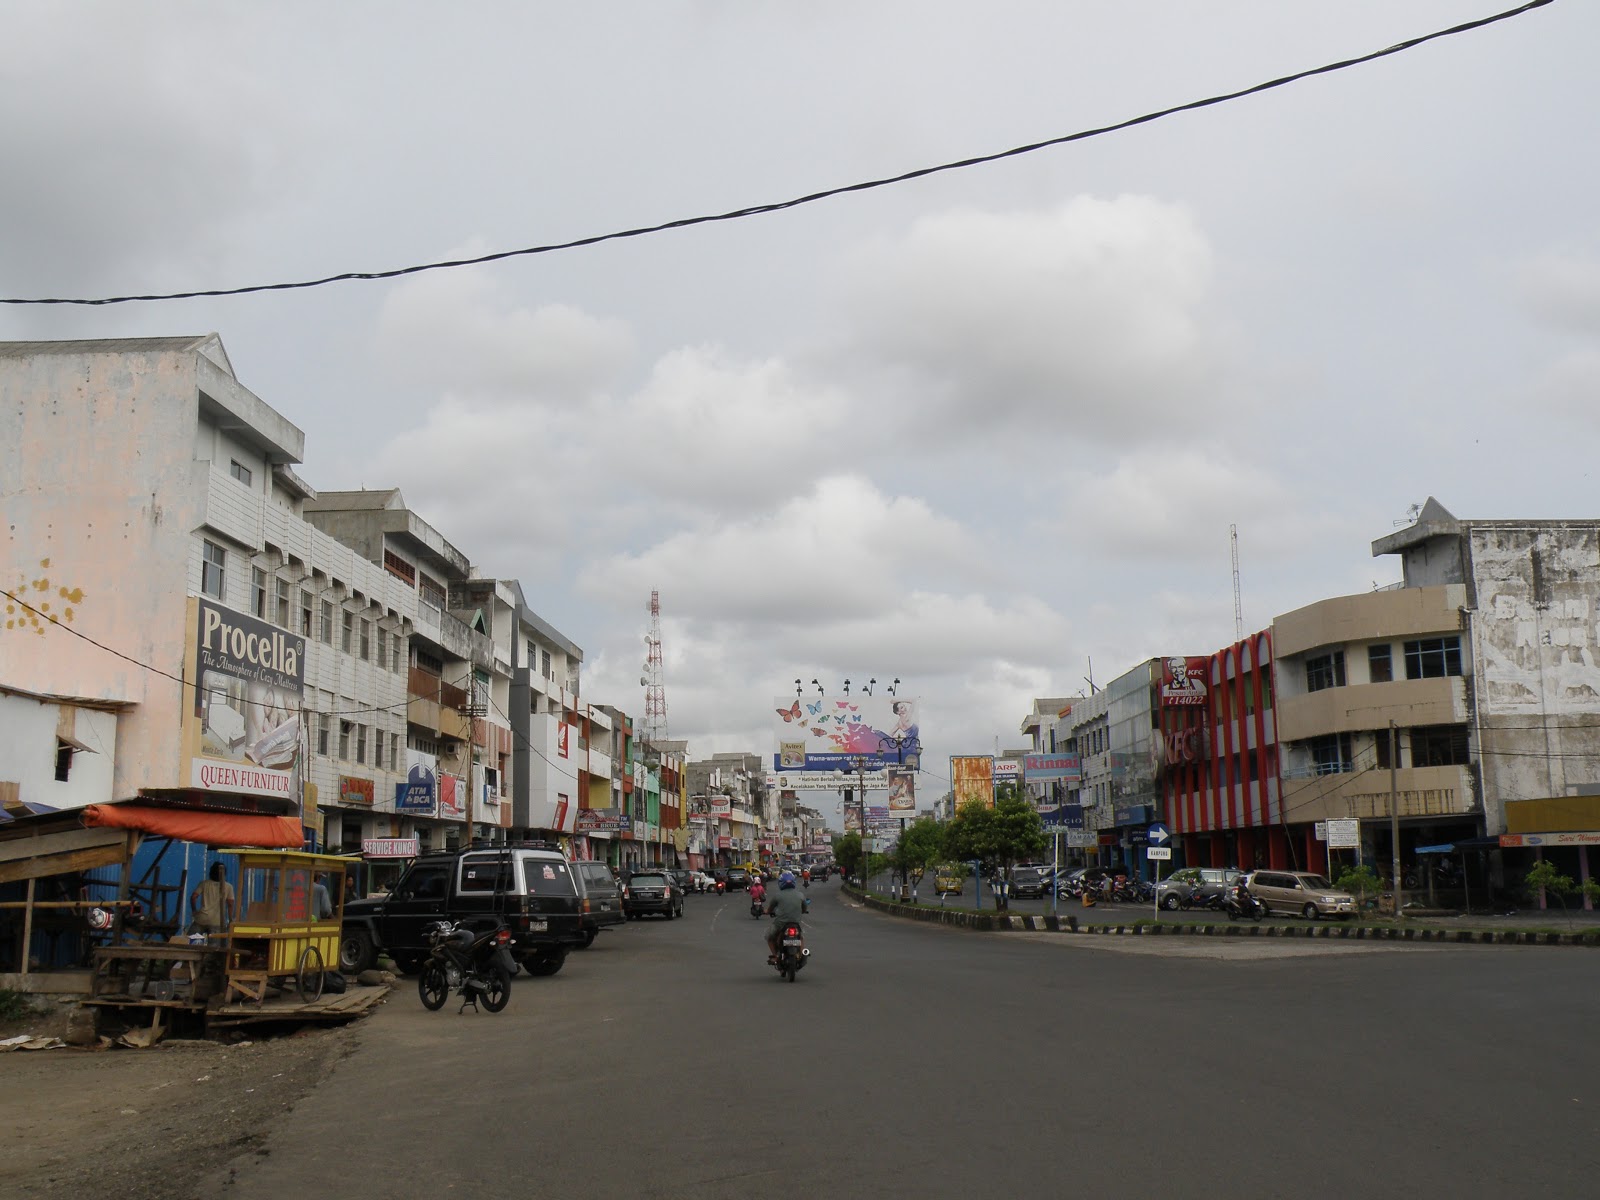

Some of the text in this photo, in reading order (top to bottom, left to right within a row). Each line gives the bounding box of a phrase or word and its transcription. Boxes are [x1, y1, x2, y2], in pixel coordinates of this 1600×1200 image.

[202, 606, 298, 676] Procella
[202, 650, 298, 691] The Atmosphere of Cozy Mattress
[1175, 696, 1203, 704] 14022
[1164, 727, 1197, 766] KFC
[1026, 756, 1079, 770] Rinnai
[200, 765, 239, 788] QUEEN
[413, 796, 430, 804] BCA
[364, 841, 415, 854] SERVICE KUNCI
